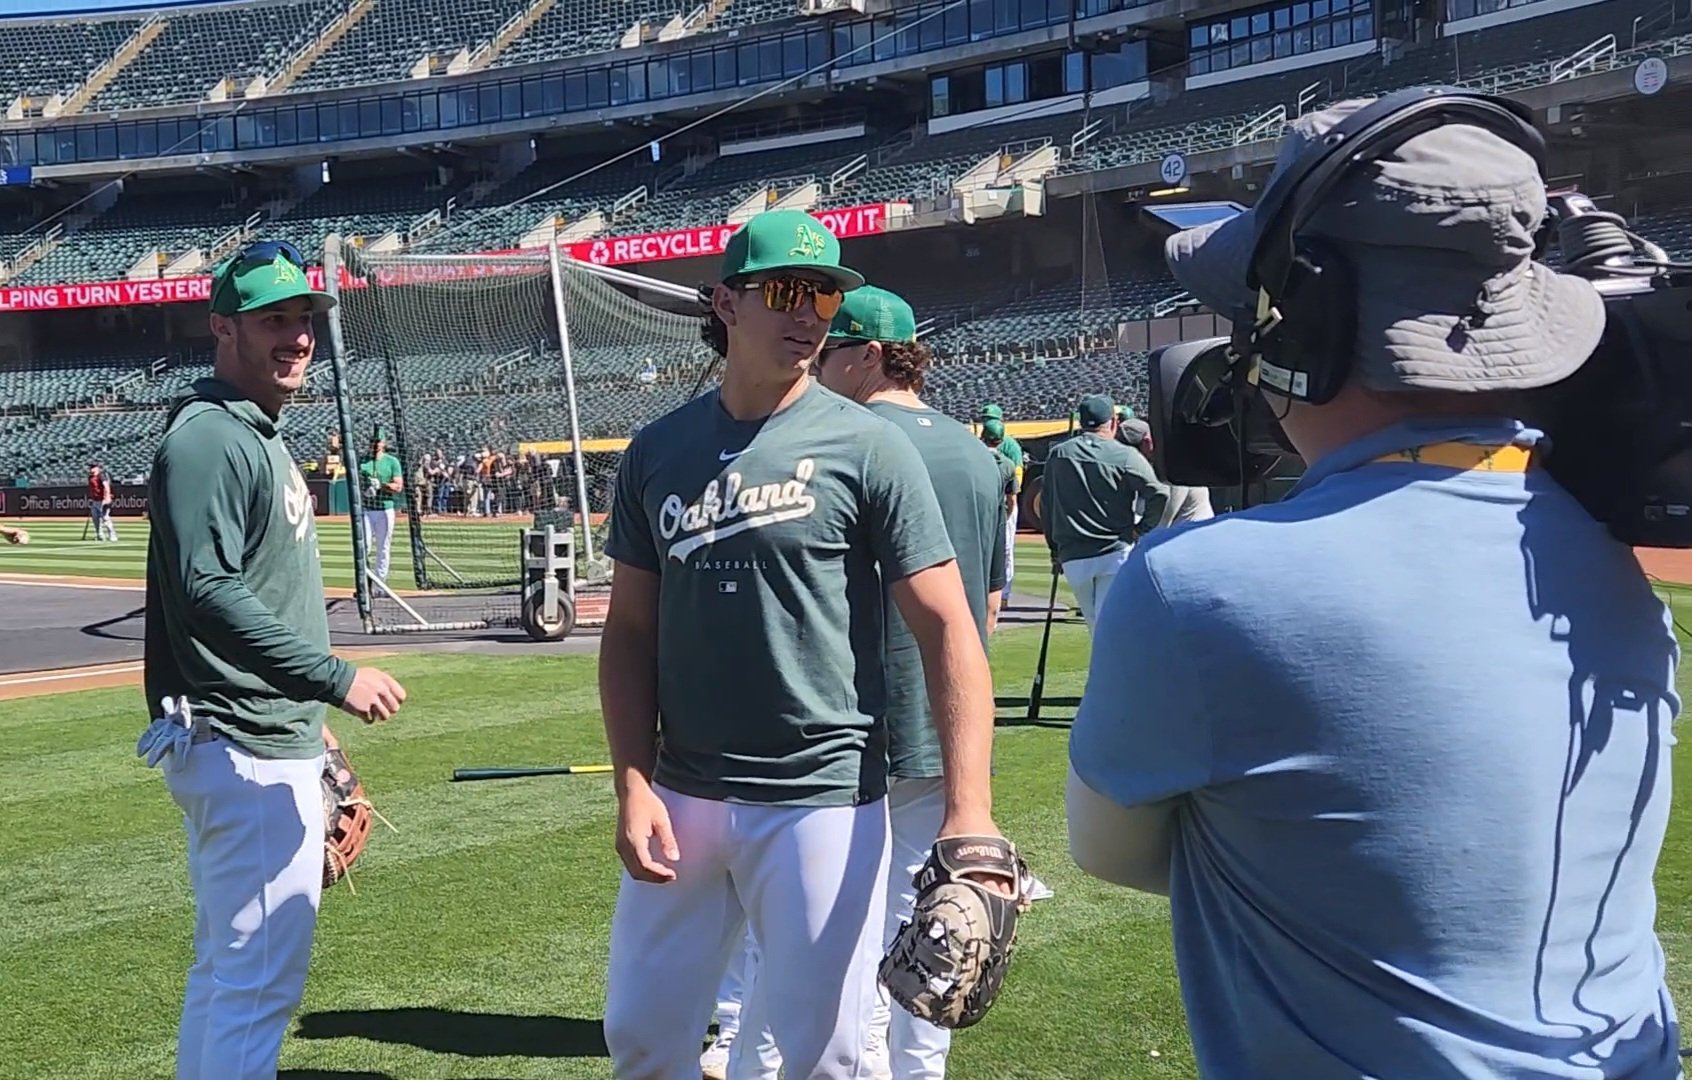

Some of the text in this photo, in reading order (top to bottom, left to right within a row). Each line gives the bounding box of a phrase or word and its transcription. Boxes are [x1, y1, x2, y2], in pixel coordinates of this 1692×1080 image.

[1163, 160, 1181, 177] 42
[614, 230, 713, 261] RECYCLE
[857, 207, 879, 232] IT
[63, 284, 120, 305] TURN
[20, 495, 49, 510] Office
[659, 458, 815, 541] Oakland
[695, 560, 768, 570] BASEBALL
[956, 844, 1004, 860] Wilson
